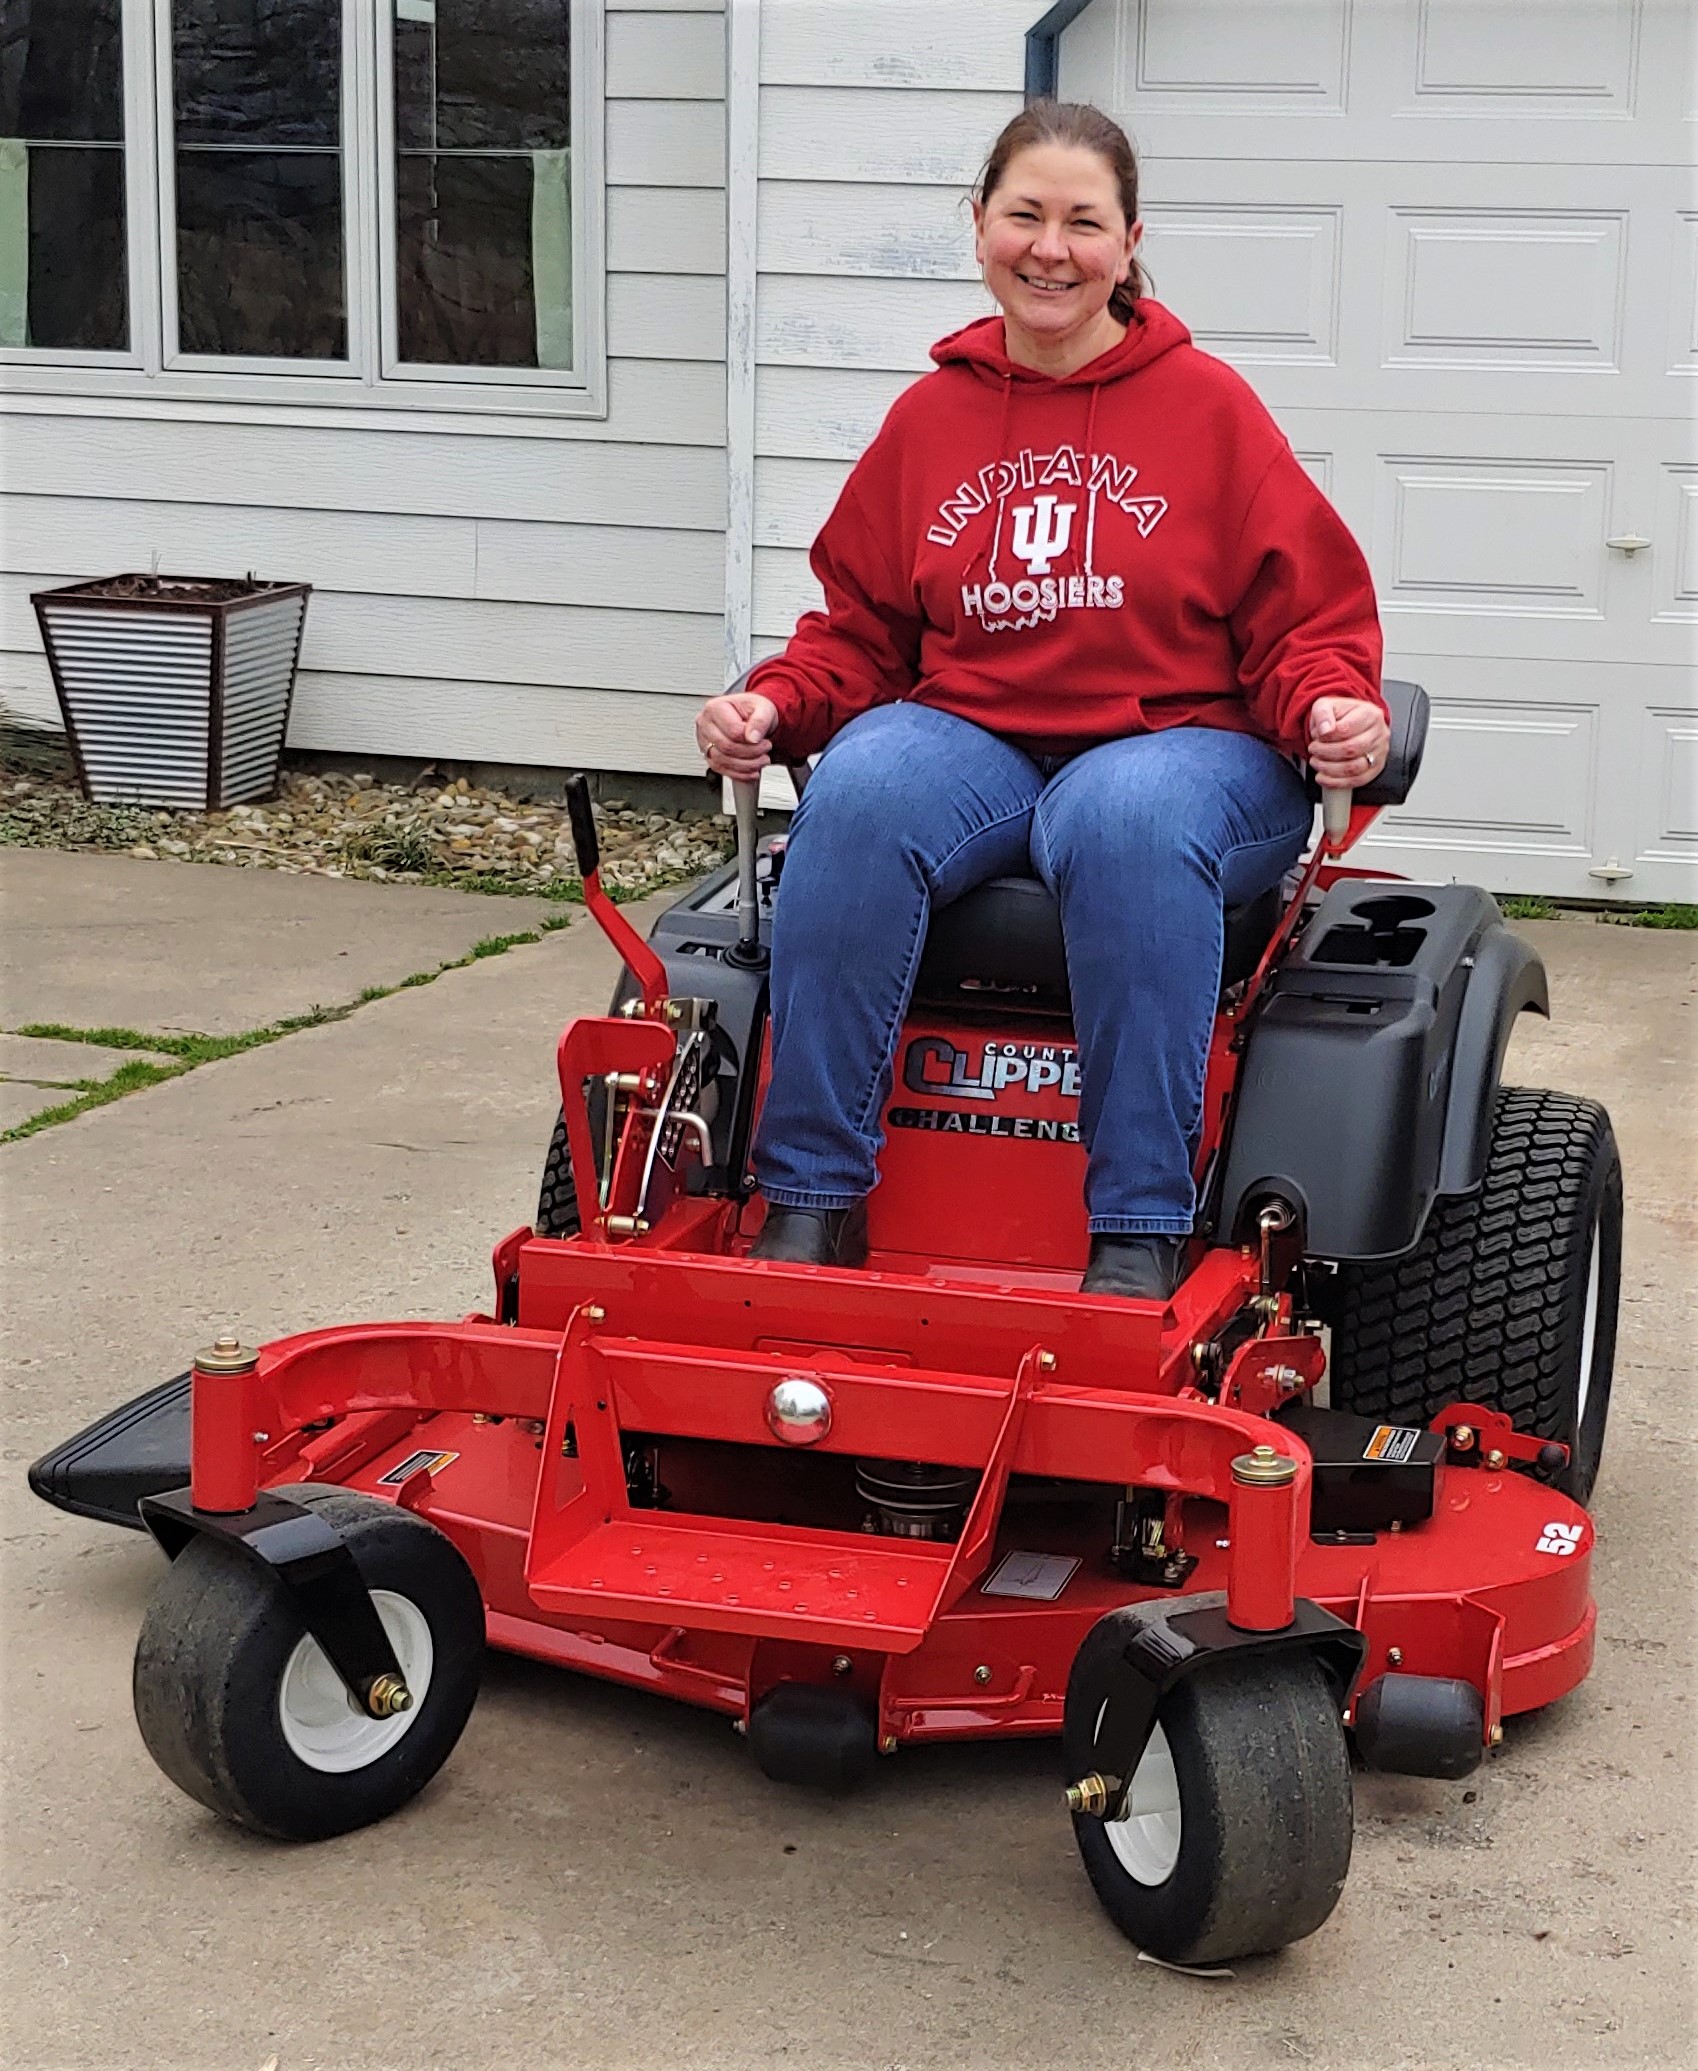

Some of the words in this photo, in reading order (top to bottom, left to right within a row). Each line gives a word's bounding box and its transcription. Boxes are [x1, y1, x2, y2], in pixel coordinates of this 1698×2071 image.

[926, 444, 1169, 547] INDIANA
[961, 574, 1124, 617] HOOSIERS
[1535, 1522, 1584, 1556] 52
